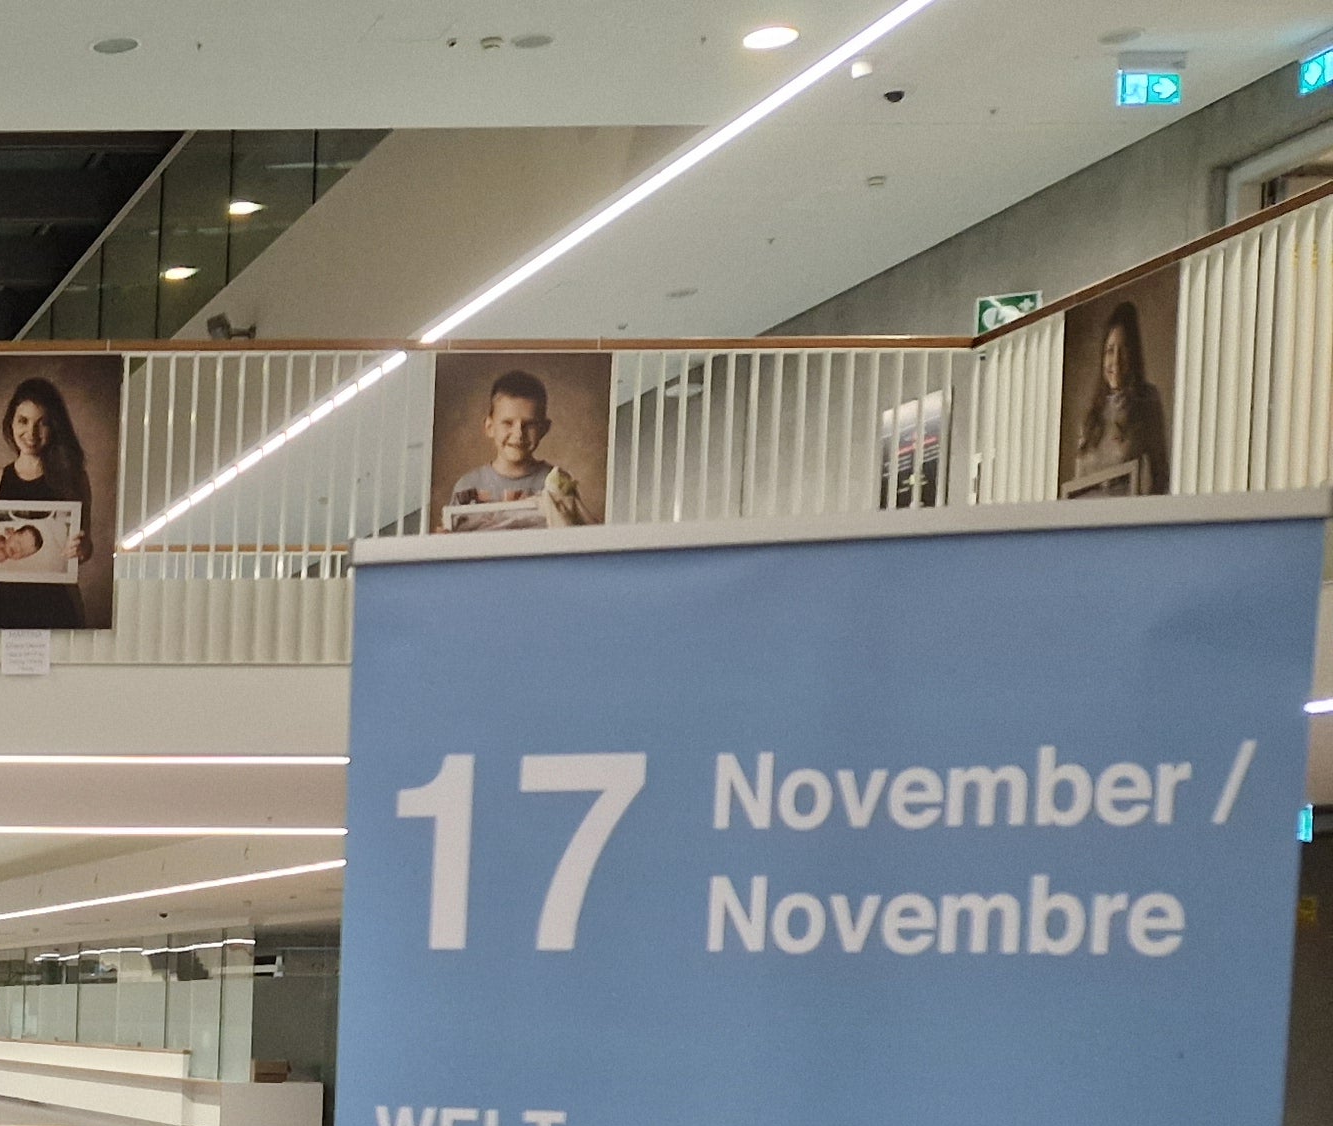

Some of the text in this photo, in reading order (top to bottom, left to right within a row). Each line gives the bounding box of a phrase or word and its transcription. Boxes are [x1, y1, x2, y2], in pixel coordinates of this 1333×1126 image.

[713, 745, 1192, 830] November
[395, 752, 647, 951] 17
[705, 874, 1185, 956] Novembre
